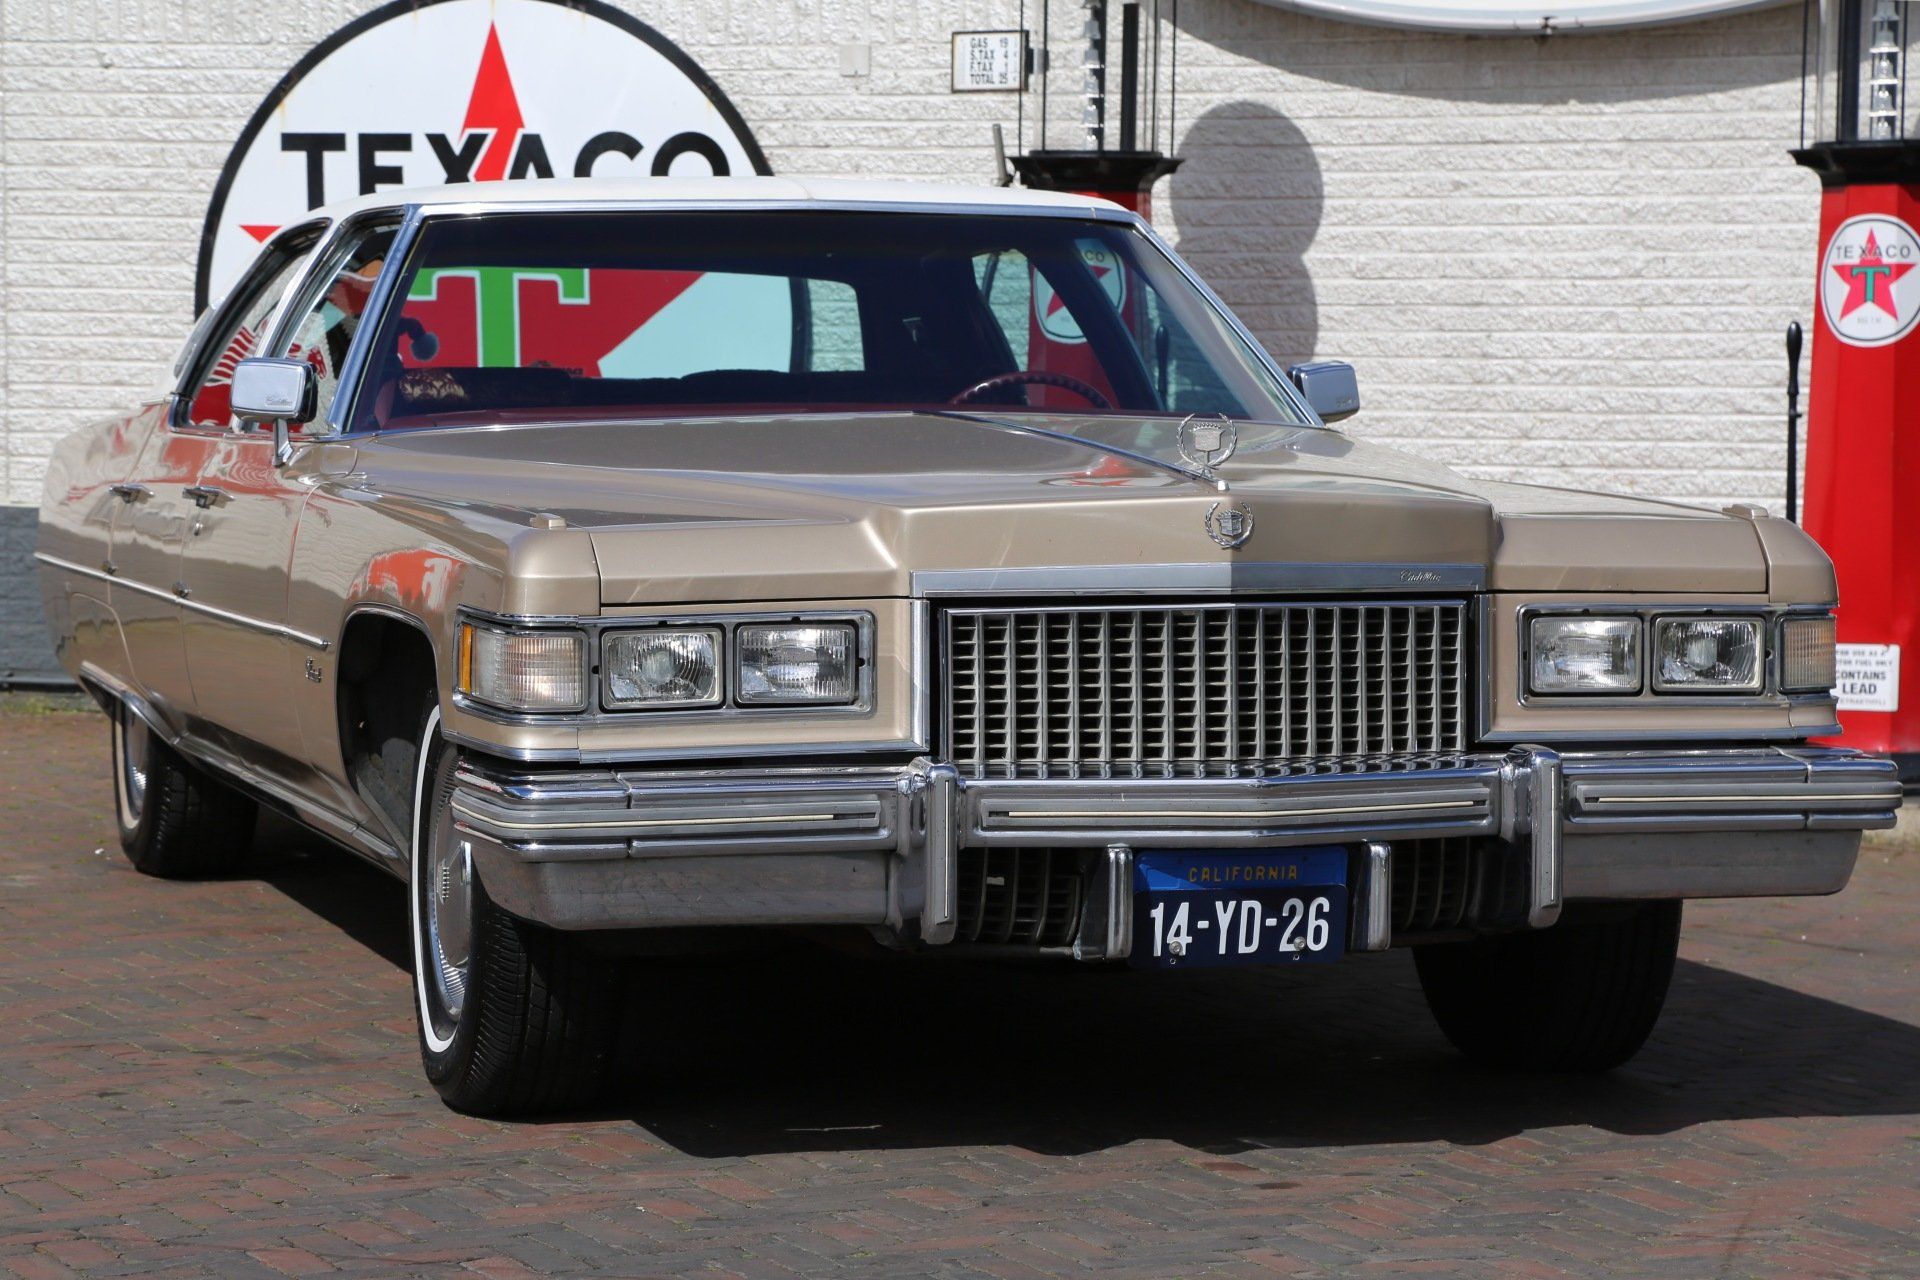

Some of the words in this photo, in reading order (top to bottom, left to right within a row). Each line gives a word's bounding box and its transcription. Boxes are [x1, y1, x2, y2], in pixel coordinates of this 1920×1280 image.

[970, 37, 988, 48] GAS
[970, 74, 996, 84] TOTAL
[1836, 244, 1911, 259] TEXACO
[1851, 266, 1891, 303] T
[1400, 568, 1441, 582] Cadillac
[1842, 683, 1877, 694] LEAD
[1189, 864, 1297, 882] CALIFORNIA
[1150, 896, 1330, 957] 14-YD-26
